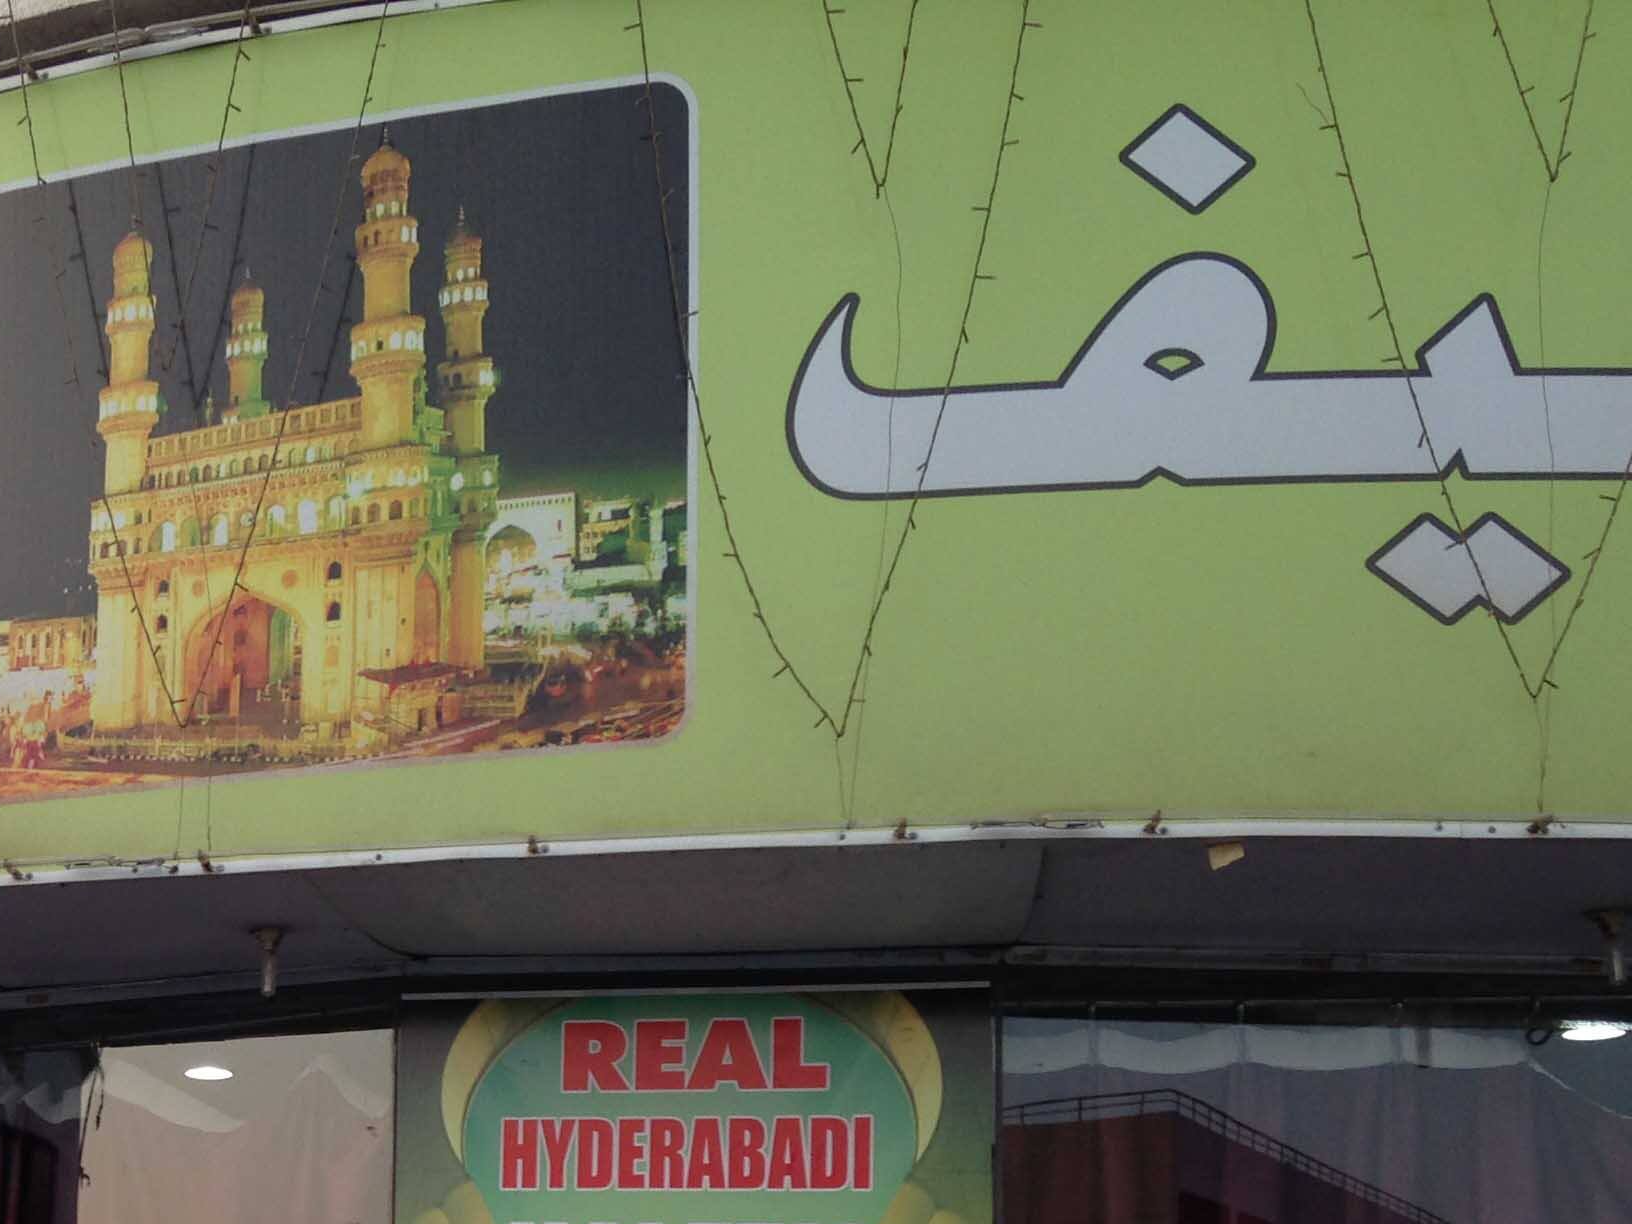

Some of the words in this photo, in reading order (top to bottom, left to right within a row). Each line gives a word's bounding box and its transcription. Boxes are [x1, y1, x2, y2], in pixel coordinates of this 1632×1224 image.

[786, 103, 1632, 626] يف
[561, 1016, 830, 1093] REAL
[499, 1115, 873, 1191] HYDERABADI
